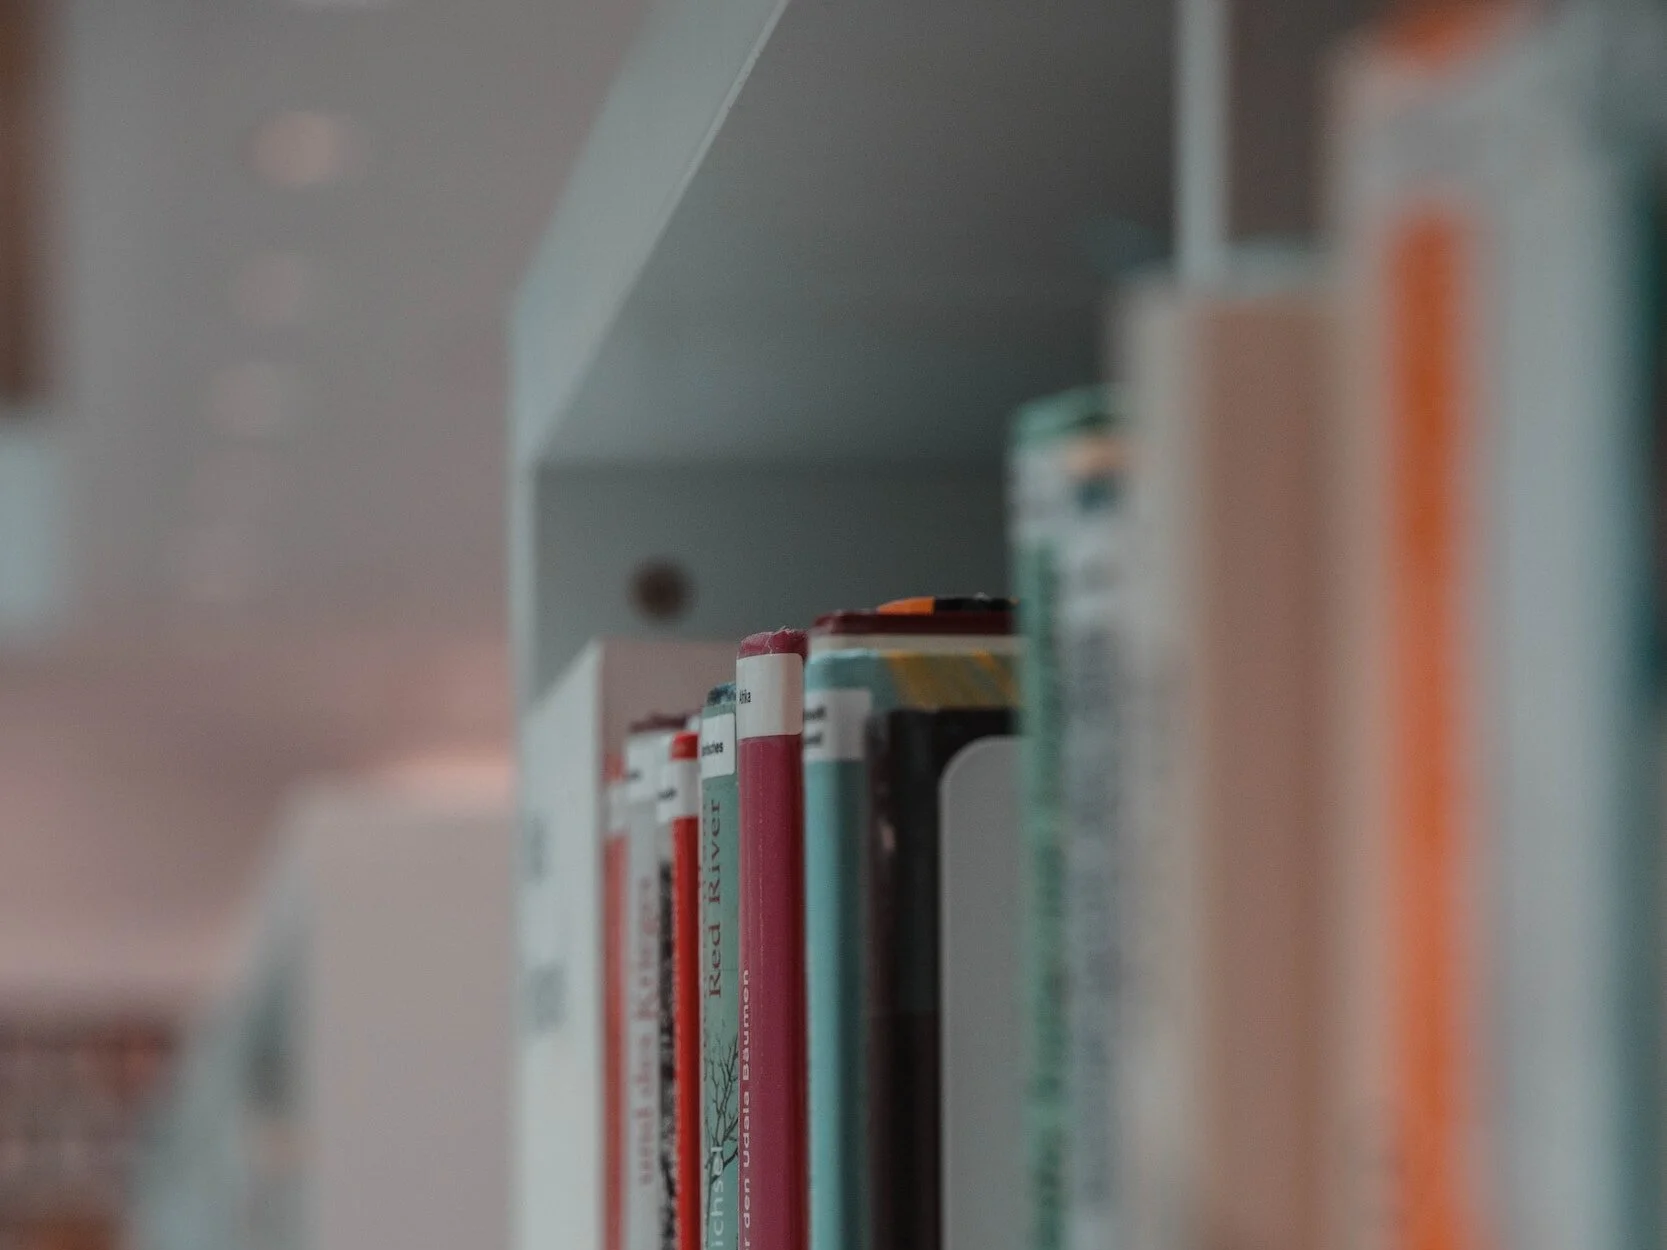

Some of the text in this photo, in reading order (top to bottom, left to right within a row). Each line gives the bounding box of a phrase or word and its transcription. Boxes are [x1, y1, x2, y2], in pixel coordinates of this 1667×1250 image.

[708, 799, 722, 998] Red River
[742, 969, 751, 1082] Bäumen
[742, 1091, 750, 1169] Udala
[742, 1177, 751, 1230] den
